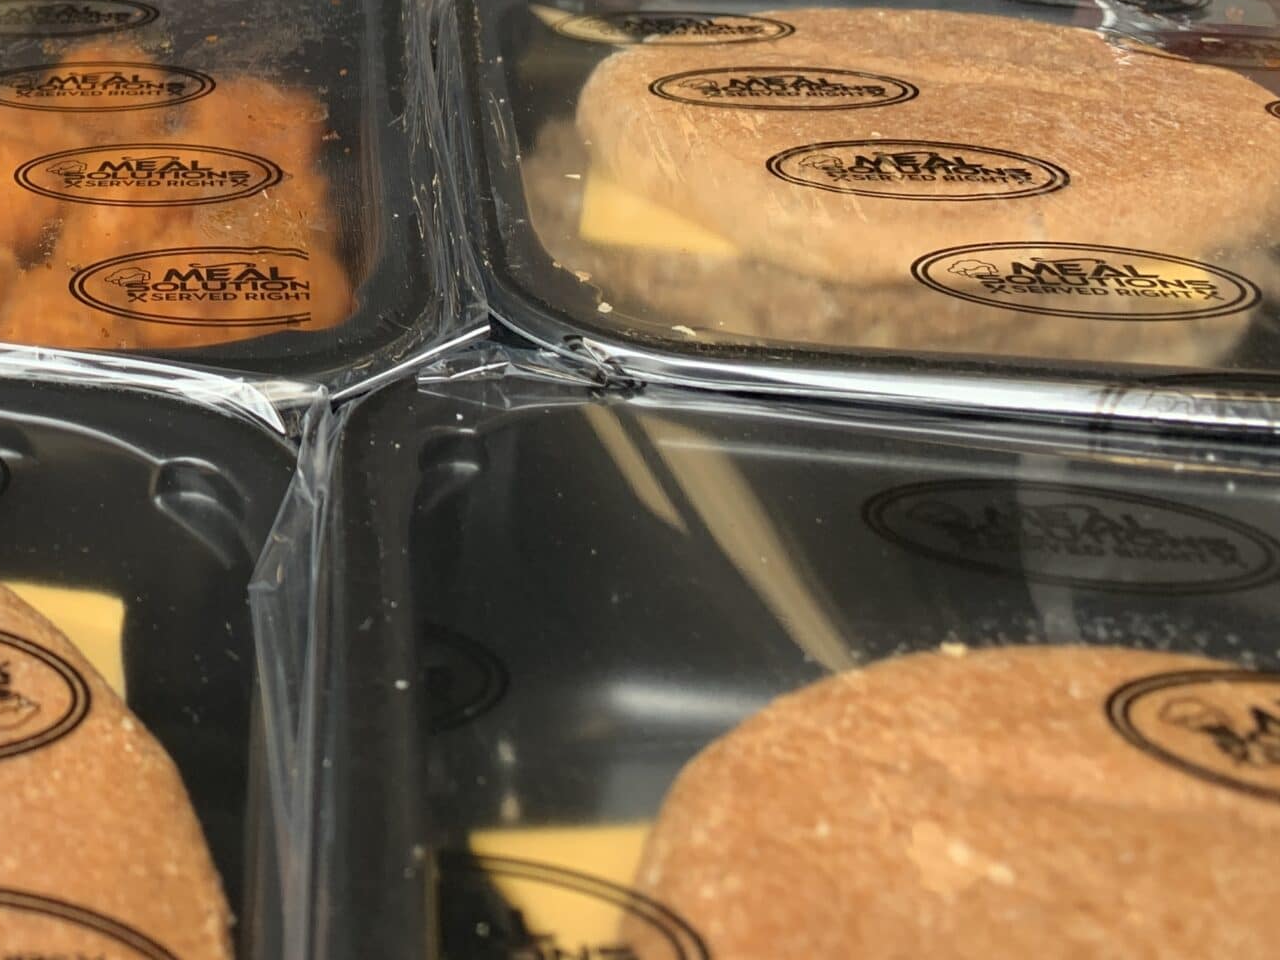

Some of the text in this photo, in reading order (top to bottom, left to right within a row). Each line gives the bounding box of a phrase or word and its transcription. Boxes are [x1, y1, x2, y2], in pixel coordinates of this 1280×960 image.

[46, 74, 149, 84] MEAL
[728, 78, 843, 89] MEAL
[97, 160, 214, 171] MEAL
[853, 154, 983, 169] MEAL
[63, 171, 251, 180] SOLUTIONS
[821, 166, 1033, 179] SOLUTIONS
[849, 173, 1012, 183] SERVED RIGHT
[162, 266, 297, 282] MEAL
[1010, 261, 1160, 279] MEAL
[975, 274, 1219, 291] SOLUTIONS
[151, 292, 238, 301] SERVED
[1008, 285, 1197, 300] SERVED RIGHT
